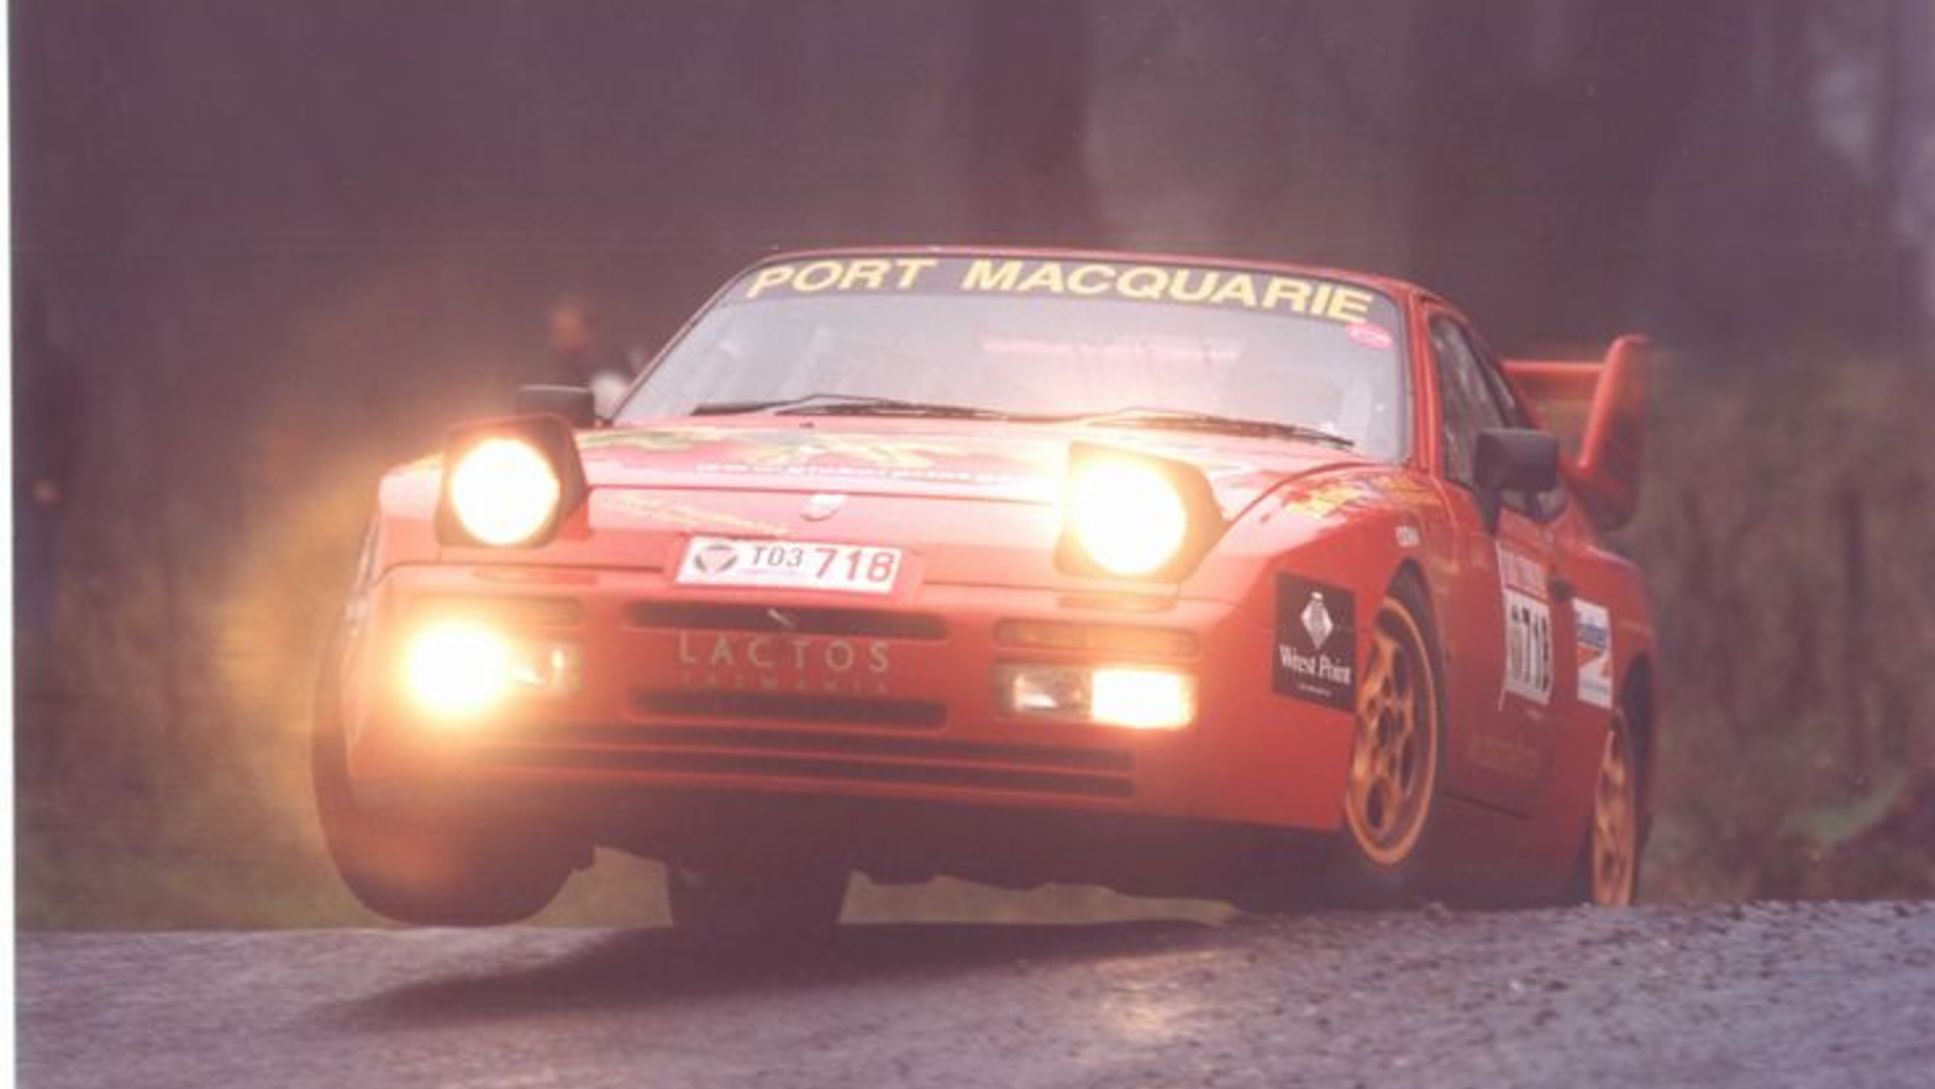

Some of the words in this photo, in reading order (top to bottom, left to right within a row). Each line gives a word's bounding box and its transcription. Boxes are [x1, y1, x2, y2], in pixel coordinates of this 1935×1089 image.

[745, 258, 938, 298] PORT
[961, 258, 1373, 324] MACQUARIE
[751, 546, 804, 567] T03
[814, 548, 896, 583] 718
[679, 630, 889, 673] LACTOS
